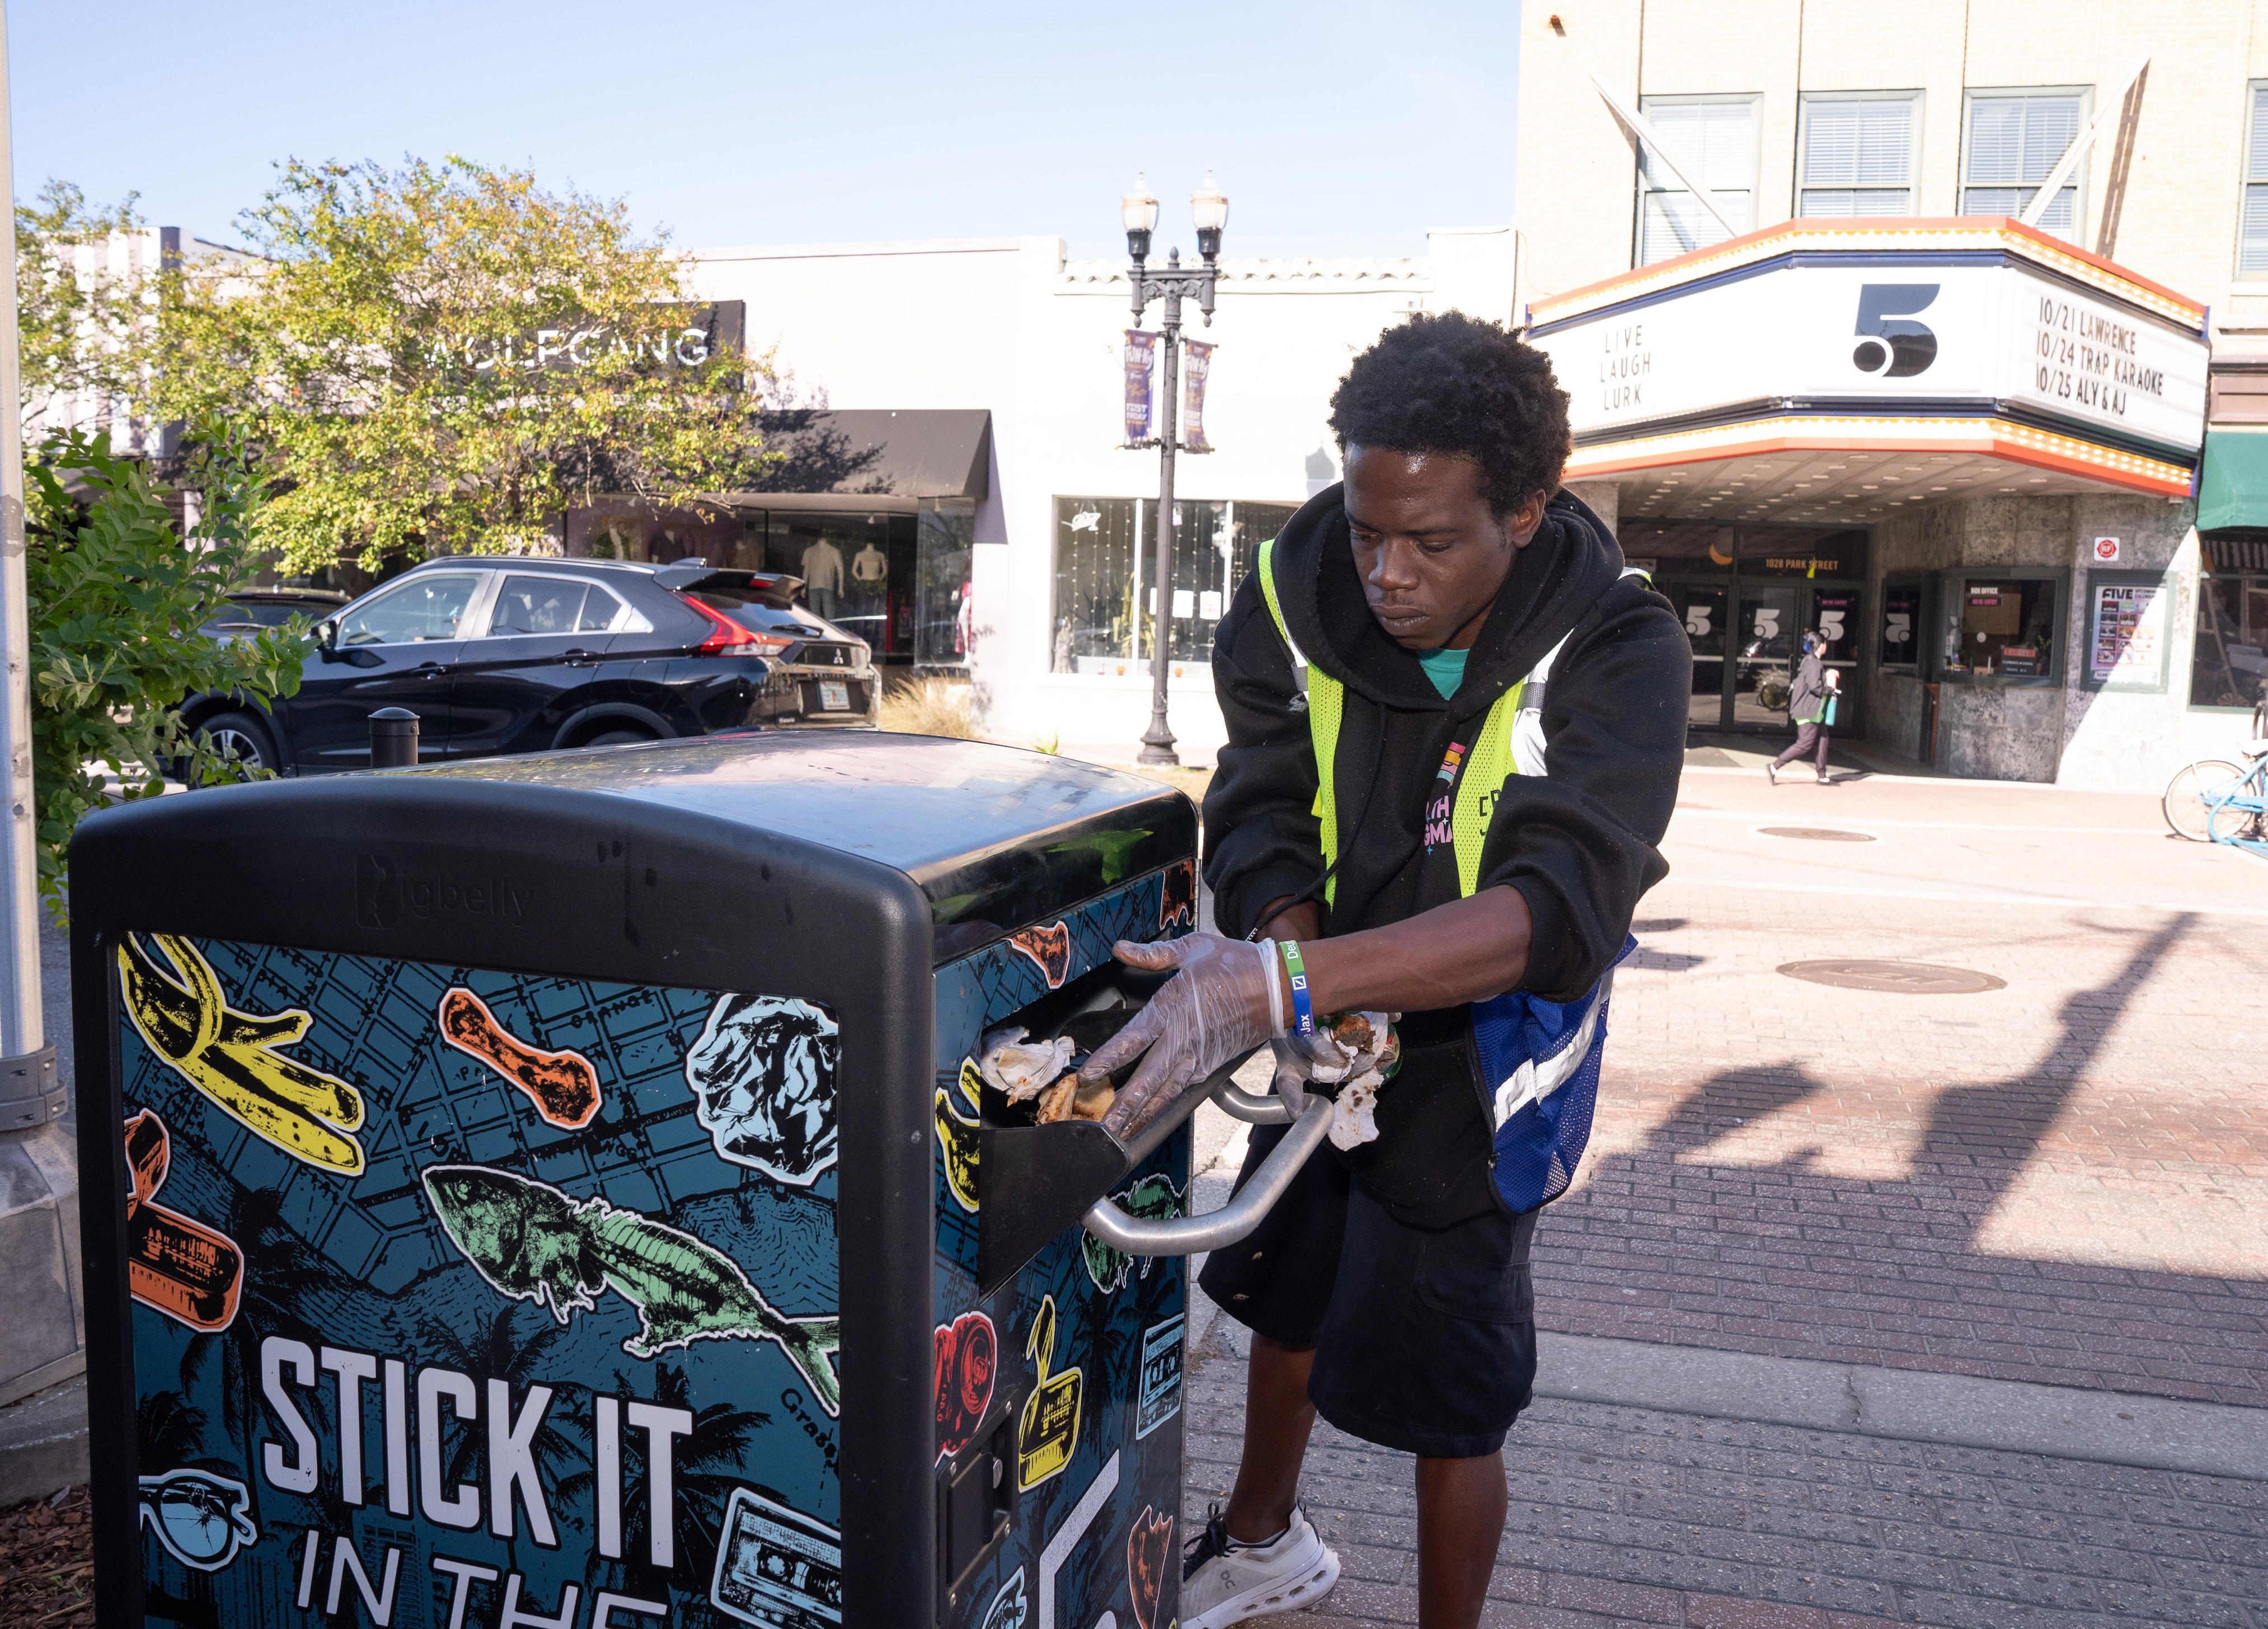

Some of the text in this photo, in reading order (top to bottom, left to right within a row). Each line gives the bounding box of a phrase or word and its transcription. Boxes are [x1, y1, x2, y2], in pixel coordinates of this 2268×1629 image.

[1605, 325, 1642, 354] LIVE
[1853, 283, 1941, 377] 5
[2040, 297, 2136, 355] 10/21 LAWRENCE
[1600, 351, 1650, 383] LAUGH
[2036, 330, 2163, 396] 10/24 TRAP KARAOKE
[1604, 383, 1641, 411] LURK
[2036, 362, 2126, 415] 10/25 ALY & AJ
[1786, 559, 1806, 569] PARK
[1809, 560, 1838, 570] STREET
[2102, 588, 2133, 599] FIVE
[1685, 605, 1712, 636] 5
[1754, 608, 1780, 640] 5
[1819, 610, 1846, 641] 5
[1300, 1013, 1311, 1032] Jax
[261, 1336, 692, 1567] STICK IT
[297, 1529, 400, 1627] IN
